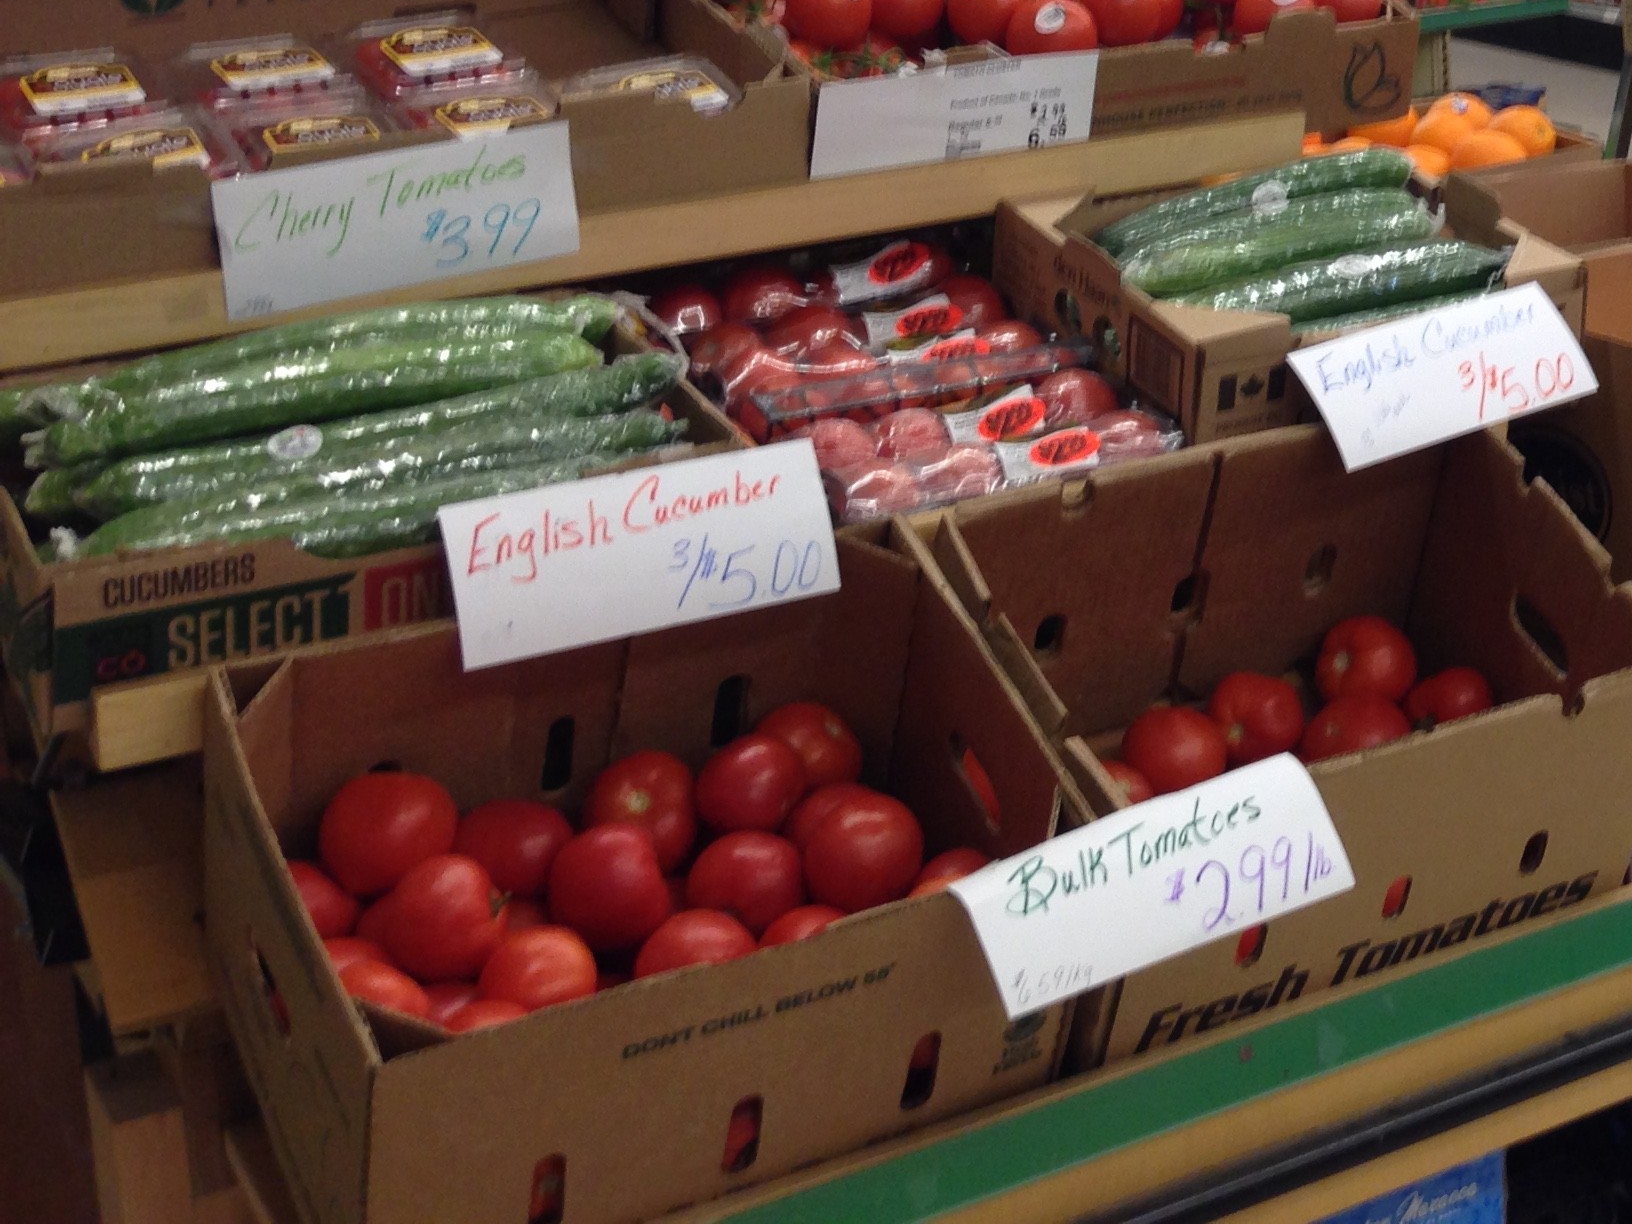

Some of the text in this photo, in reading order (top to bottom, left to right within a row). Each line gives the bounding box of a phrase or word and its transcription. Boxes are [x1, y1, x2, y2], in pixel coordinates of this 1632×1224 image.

[234, 143, 527, 256] Cherry Tomatoes
[1316, 302, 1537, 395] English Cucumber
[466, 471, 781, 582] English Cucumber
[104, 552, 256, 609] CUCUMBERS
[167, 589, 331, 671] SELECT
[1006, 794, 1263, 918] Bulk Tomatoes
[701, 1004, 769, 1036] CHILL
[774, 976, 858, 1014] BELOW
[1134, 868, 1600, 1055] Fresh Tomatoes
